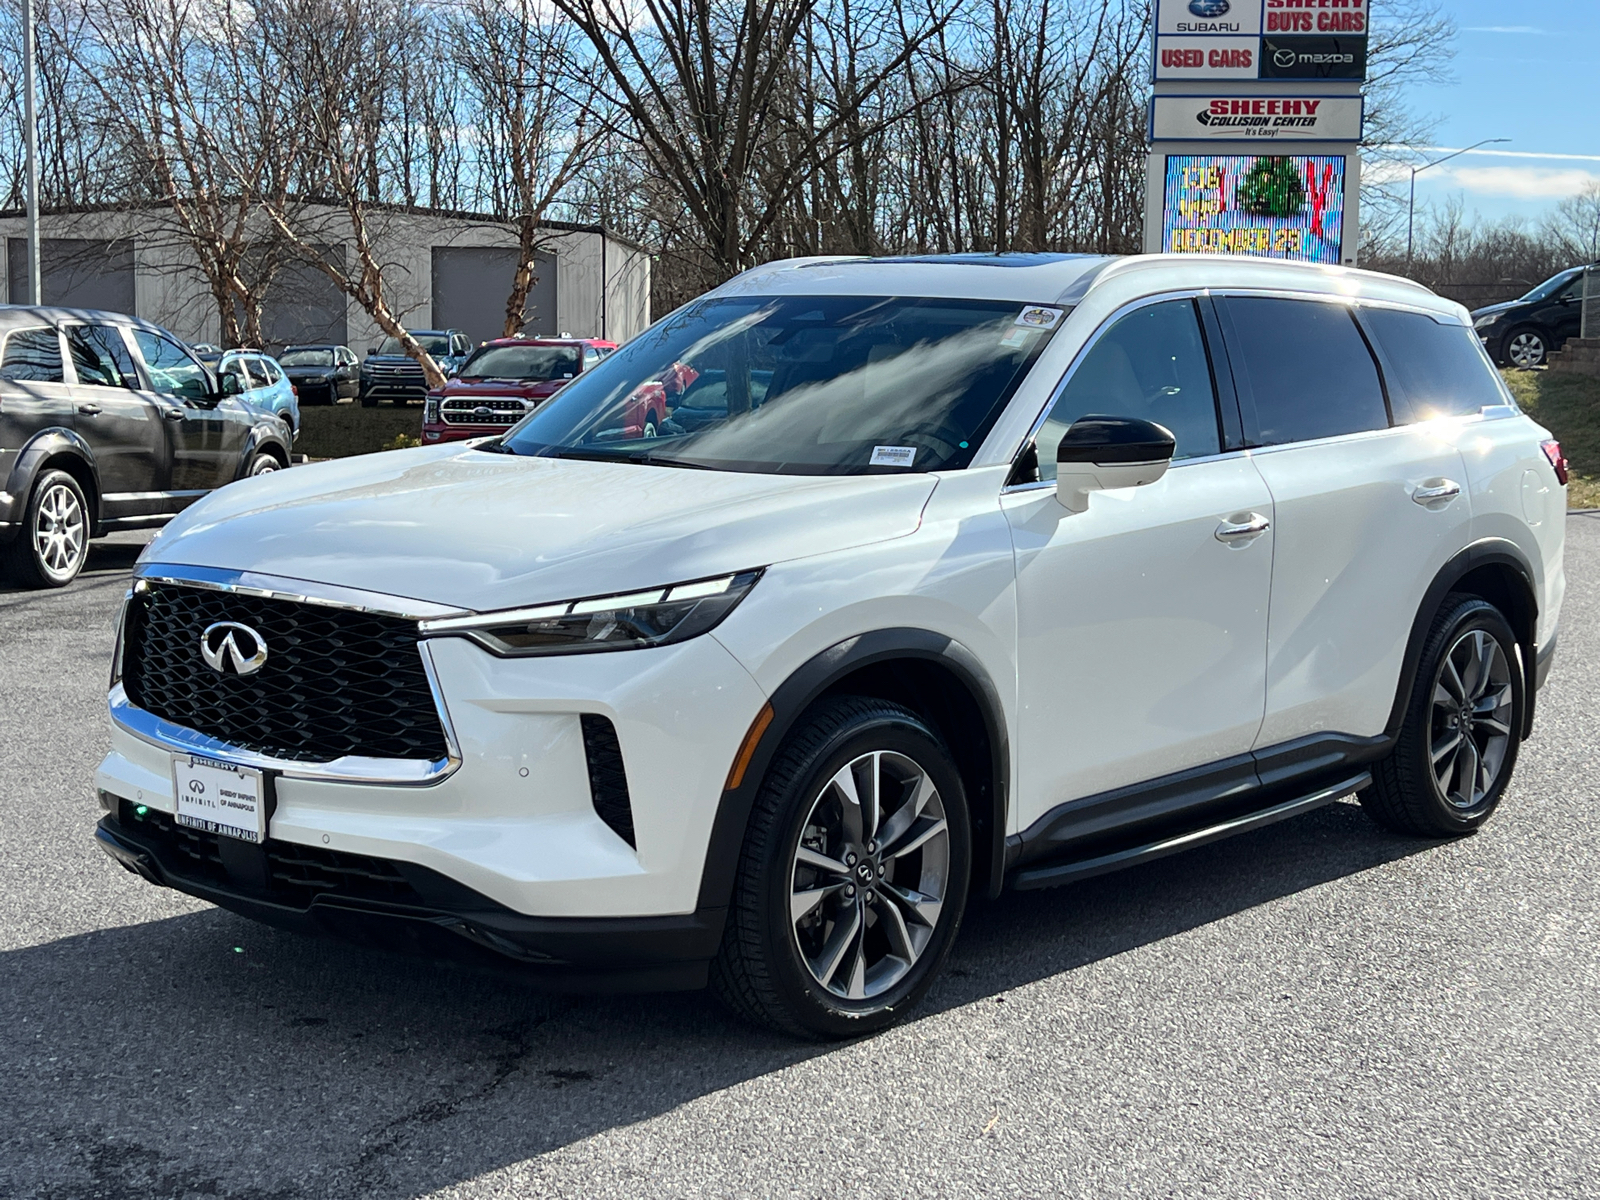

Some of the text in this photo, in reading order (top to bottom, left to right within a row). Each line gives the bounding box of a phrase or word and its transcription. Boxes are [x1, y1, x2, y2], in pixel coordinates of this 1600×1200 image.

[1176, 22, 1240, 32] SUBARU
[1267, 11, 1365, 31] BUYS CARS
[1161, 49, 1253, 68] USED CARS
[1299, 53, 1353, 63] mazda
[1209, 100, 1322, 115] SHEEHY
[1209, 116, 1317, 127] COLLISION CENTER
[1245, 127, 1279, 137] It's Easy!
[191, 757, 237, 772] SHEEHY
[181, 794, 216, 809] INFINITI
[178, 814, 258, 843] INFINITI OF ANNAPOLIS
